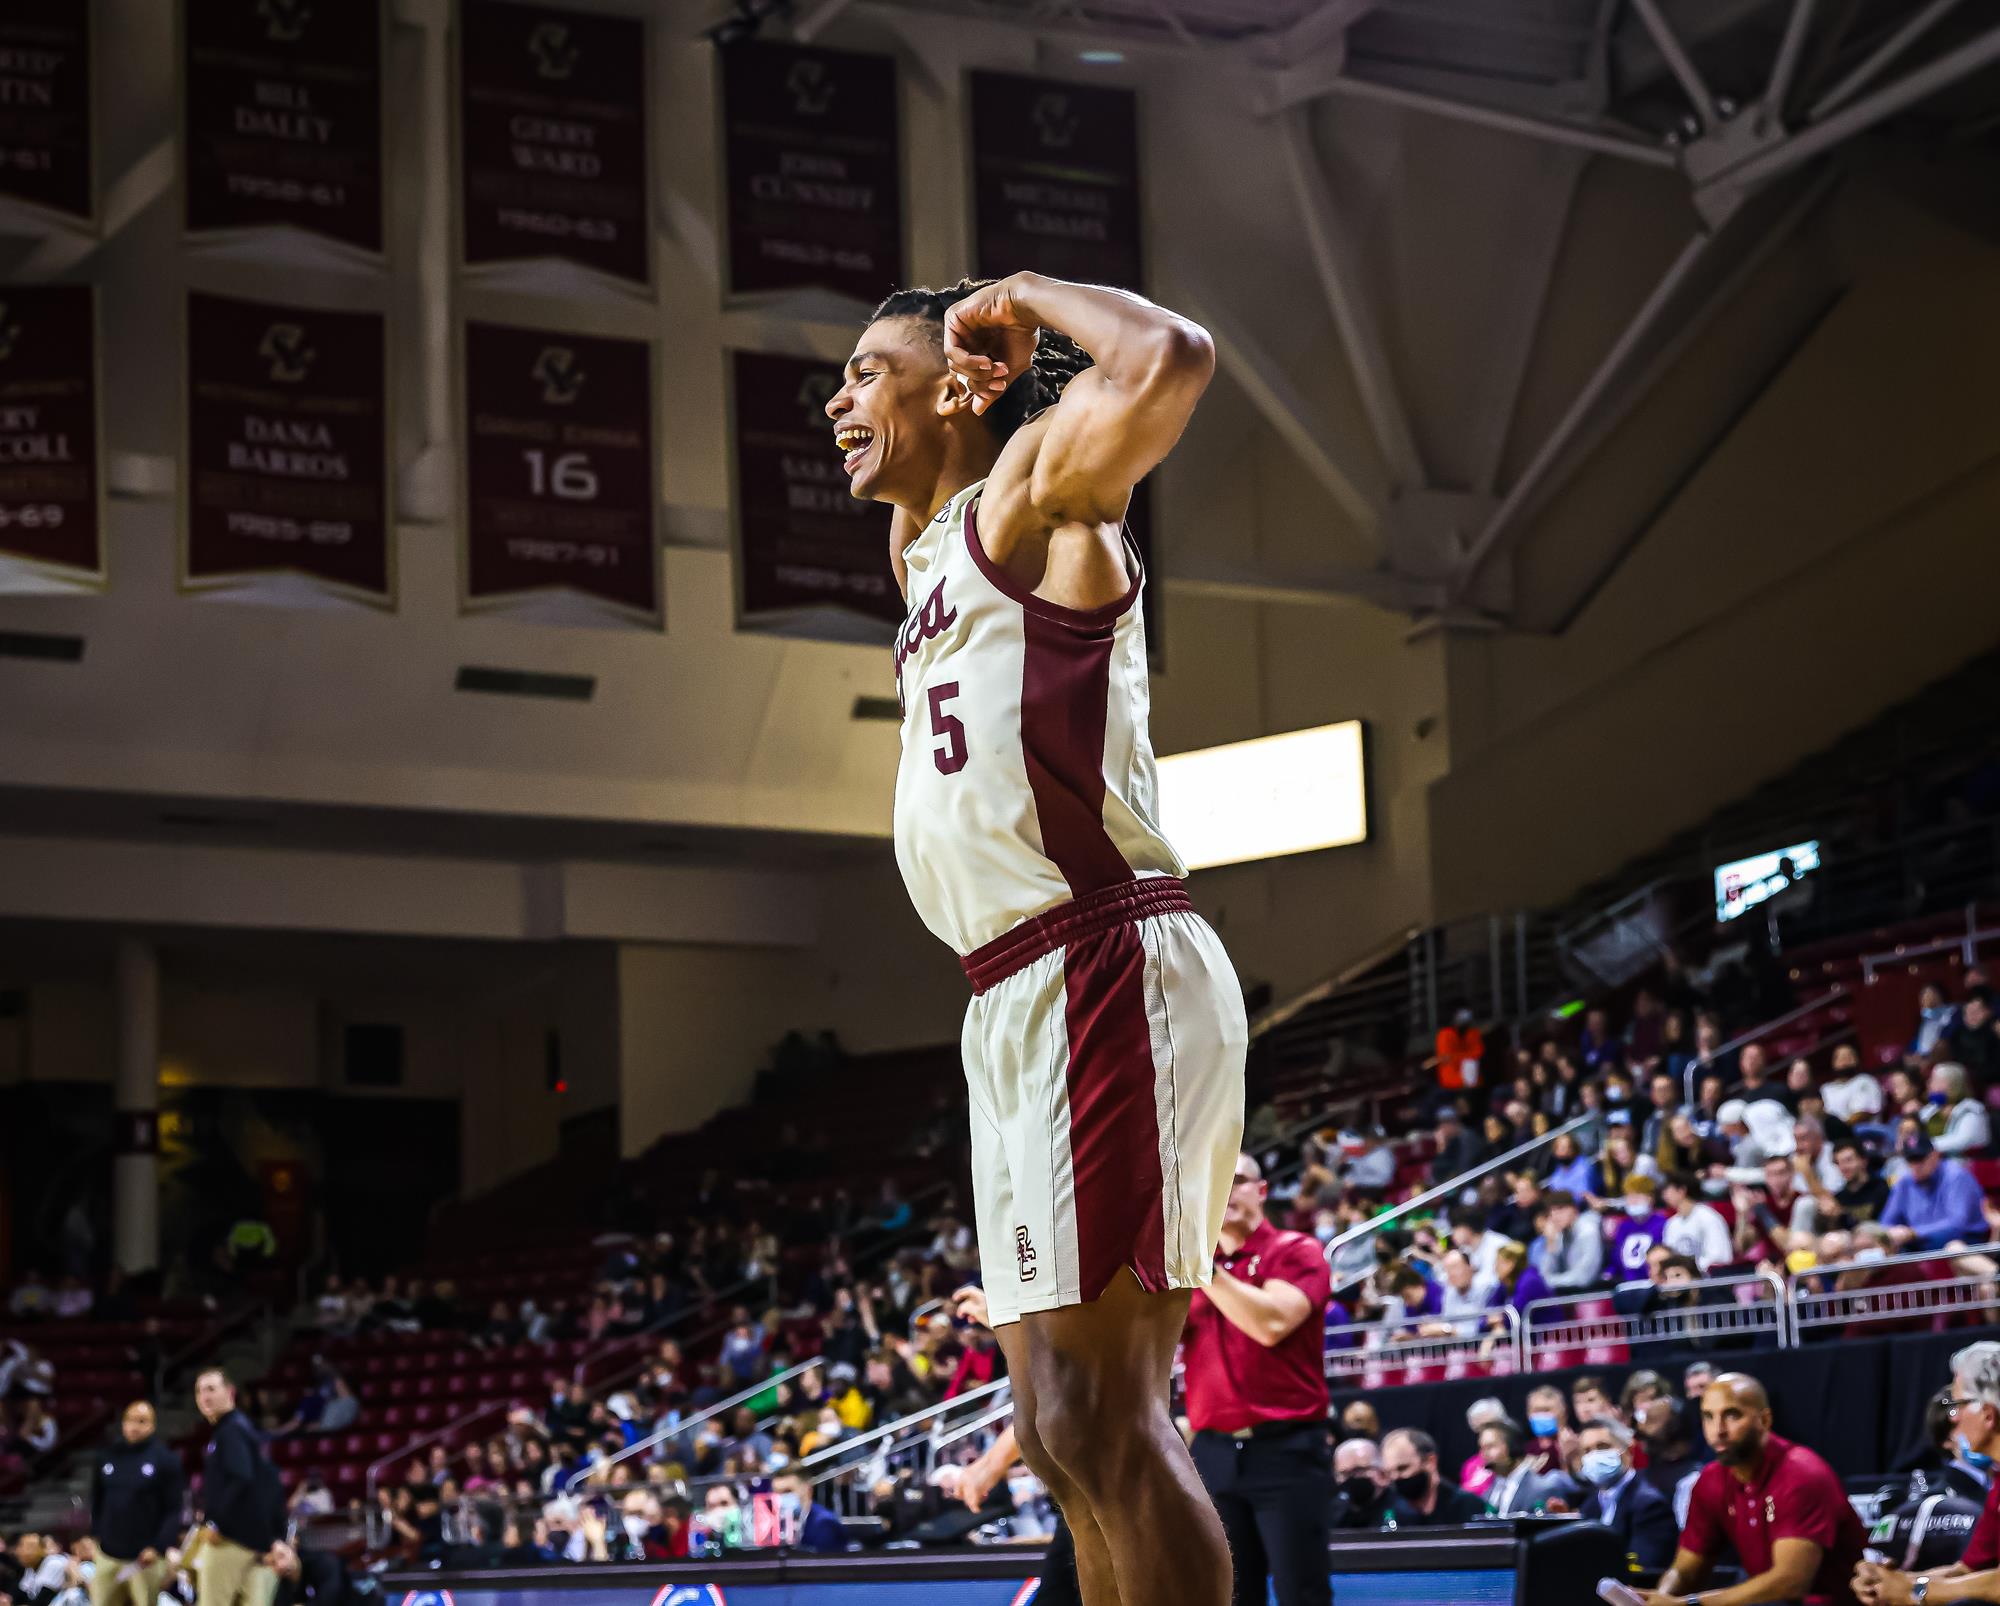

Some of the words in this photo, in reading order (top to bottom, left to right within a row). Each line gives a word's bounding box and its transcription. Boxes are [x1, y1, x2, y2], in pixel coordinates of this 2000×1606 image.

[0, 76, 54, 107] TIN
[234, 104, 335, 145] DALEY
[510, 143, 602, 178] WARD
[0, 404, 39, 431] RY
[244, 414, 333, 450] DANA
[0, 431, 72, 463] COLL
[227, 440, 350, 480] BARROS
[521, 447, 600, 501] 16
[928, 681, 969, 776] 5
